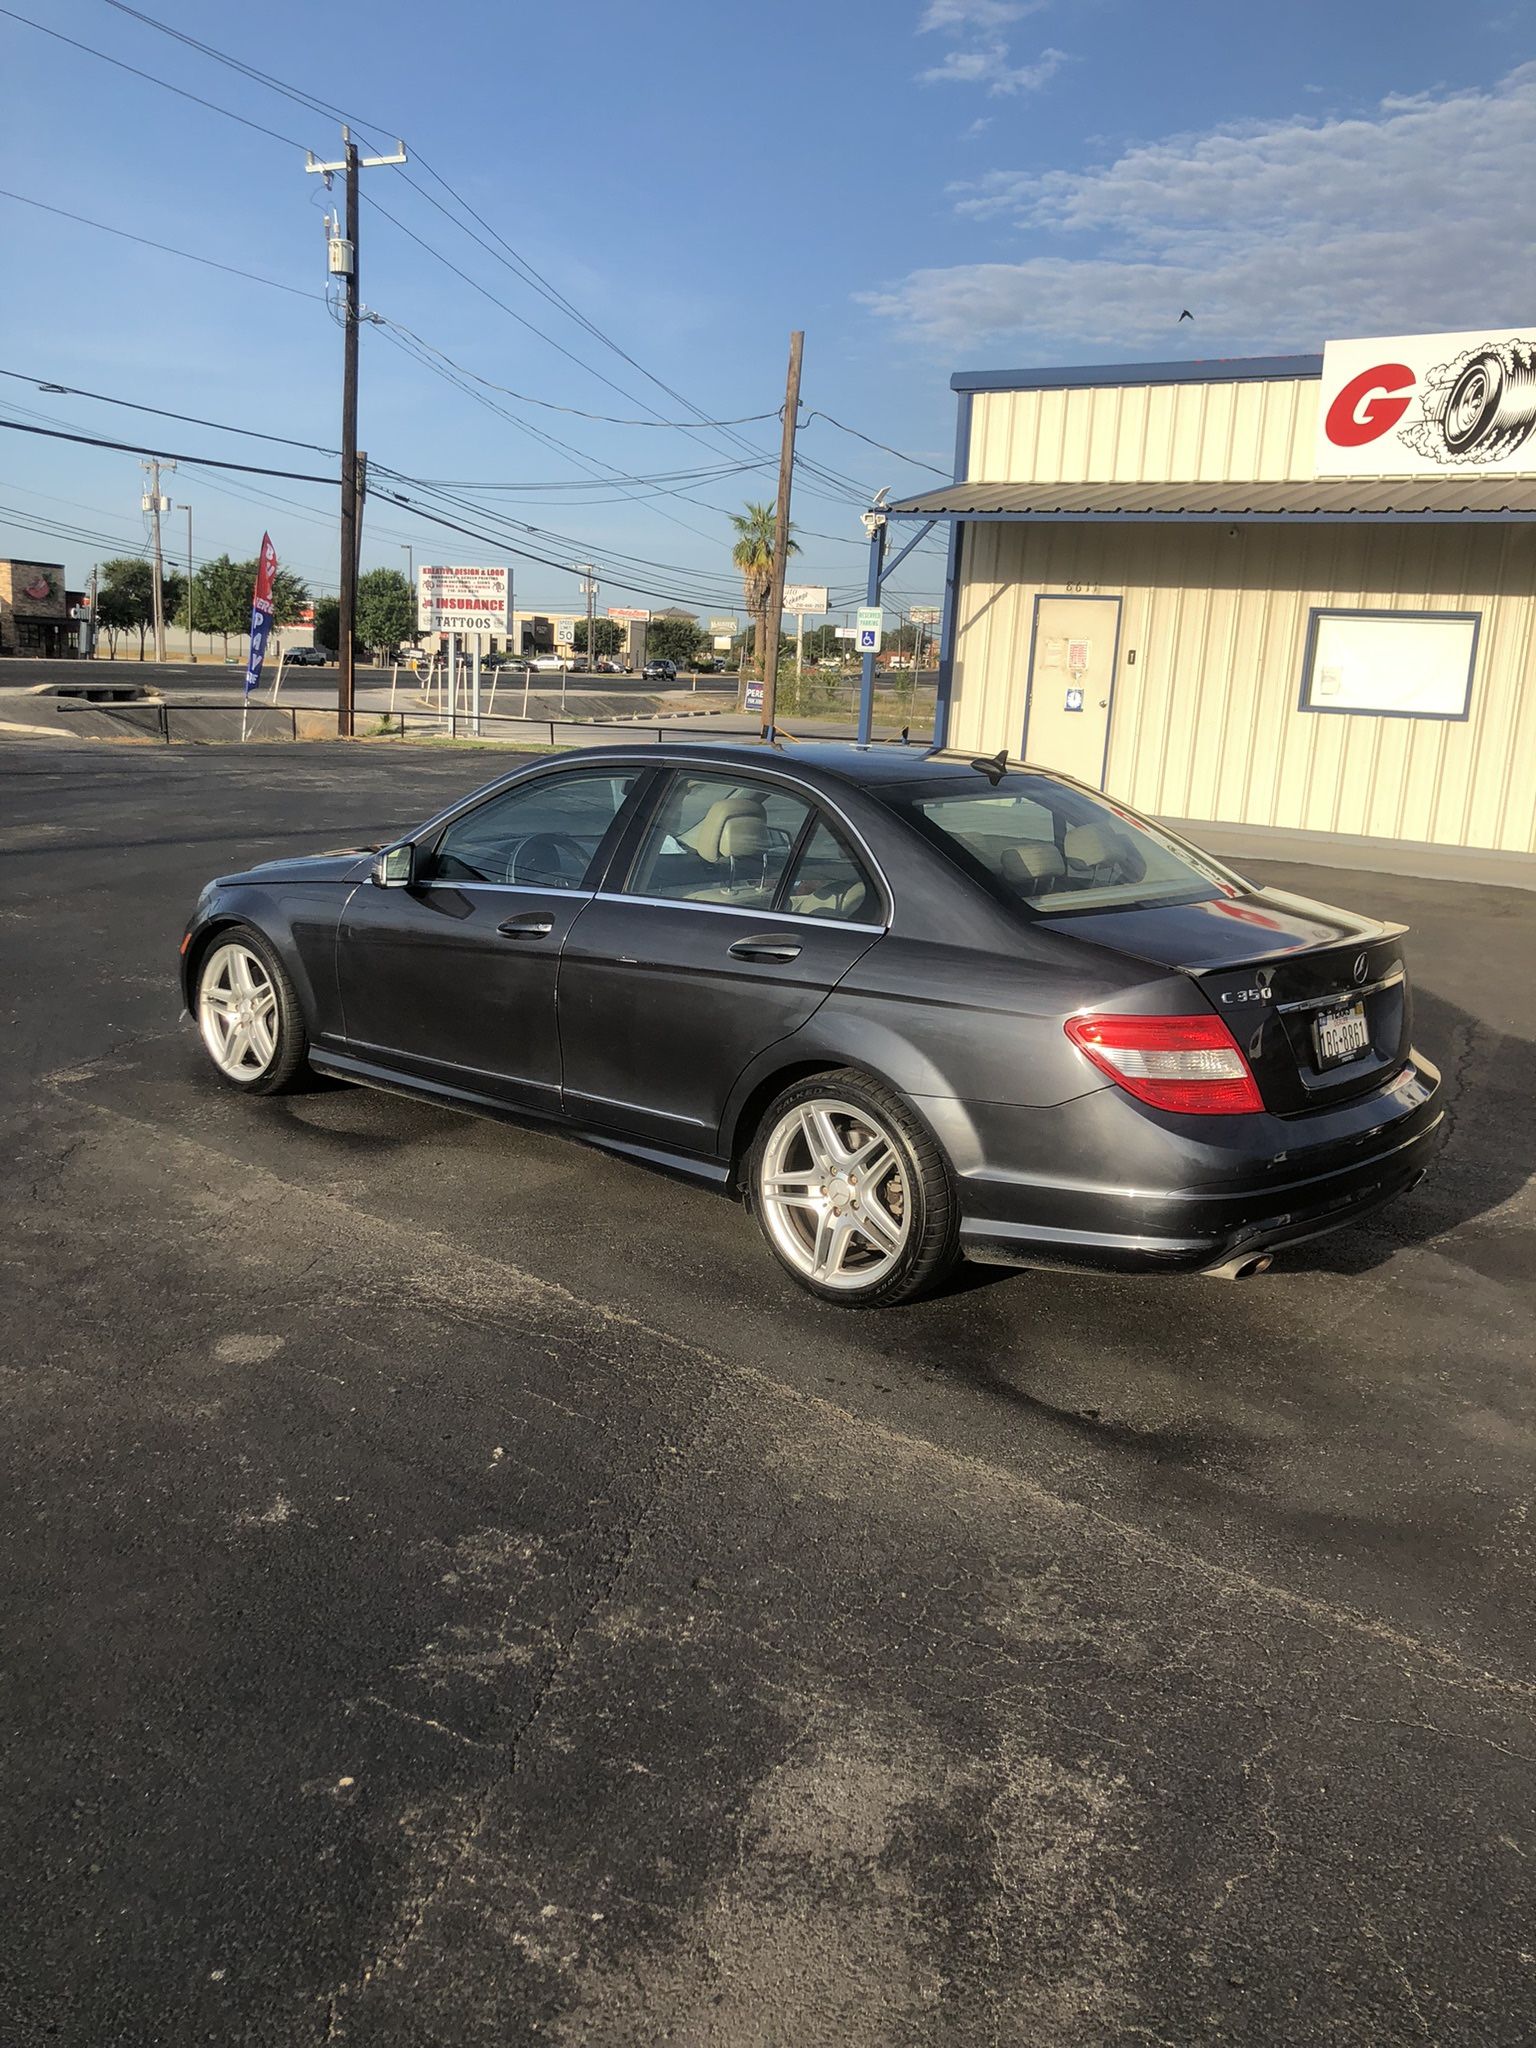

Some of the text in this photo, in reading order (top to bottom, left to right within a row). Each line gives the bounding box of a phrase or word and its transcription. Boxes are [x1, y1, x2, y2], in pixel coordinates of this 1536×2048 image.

[1325, 363, 1416, 447] G
[454, 568, 480, 576] DESIGN
[487, 569, 505, 577] LOGO
[436, 598, 505, 611] INSURANCE
[435, 616, 491, 629] TATTOOS
[559, 630, 573, 641] 50
[1221, 987, 1272, 1004] C 350
